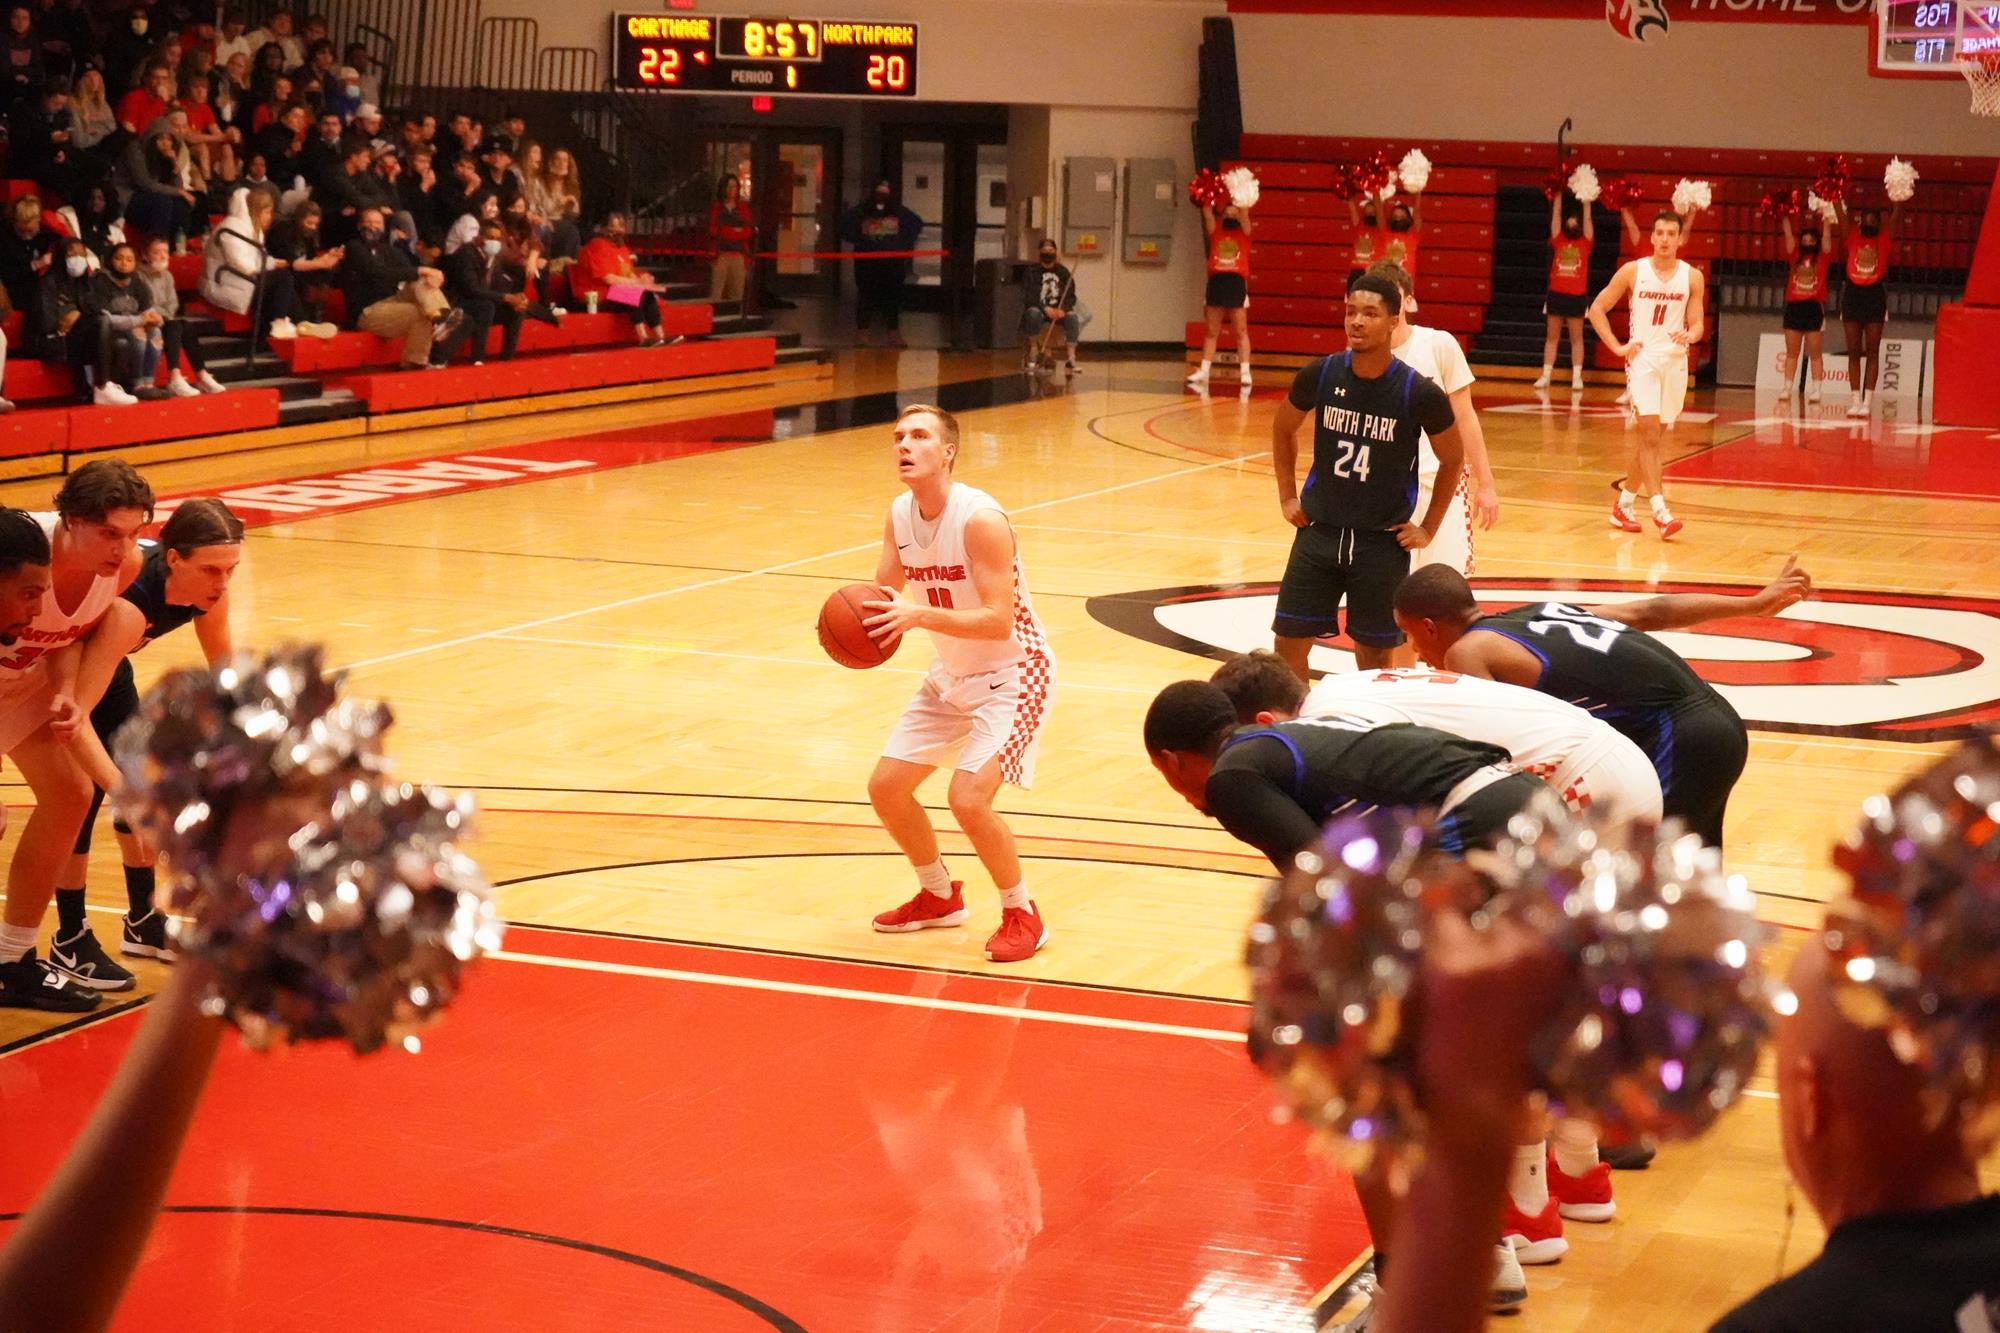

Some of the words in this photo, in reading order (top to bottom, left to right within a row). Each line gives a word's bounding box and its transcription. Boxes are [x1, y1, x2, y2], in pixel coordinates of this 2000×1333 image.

[628, 17, 711, 40] CARTHAGE
[744, 22, 816, 57] 8:57
[639, 48, 680, 82] 22
[731, 69, 773, 84] PERIOD
[787, 65, 797, 89] 1
[867, 55, 905, 87] 20
[1638, 291, 1684, 301] CARTHAGE
[1652, 304, 1667, 326] 11
[1883, 343, 1901, 391] BLACK
[1323, 405, 1360, 436] NORTH
[1362, 413, 1397, 442] PARK
[1333, 440, 1370, 482] 24
